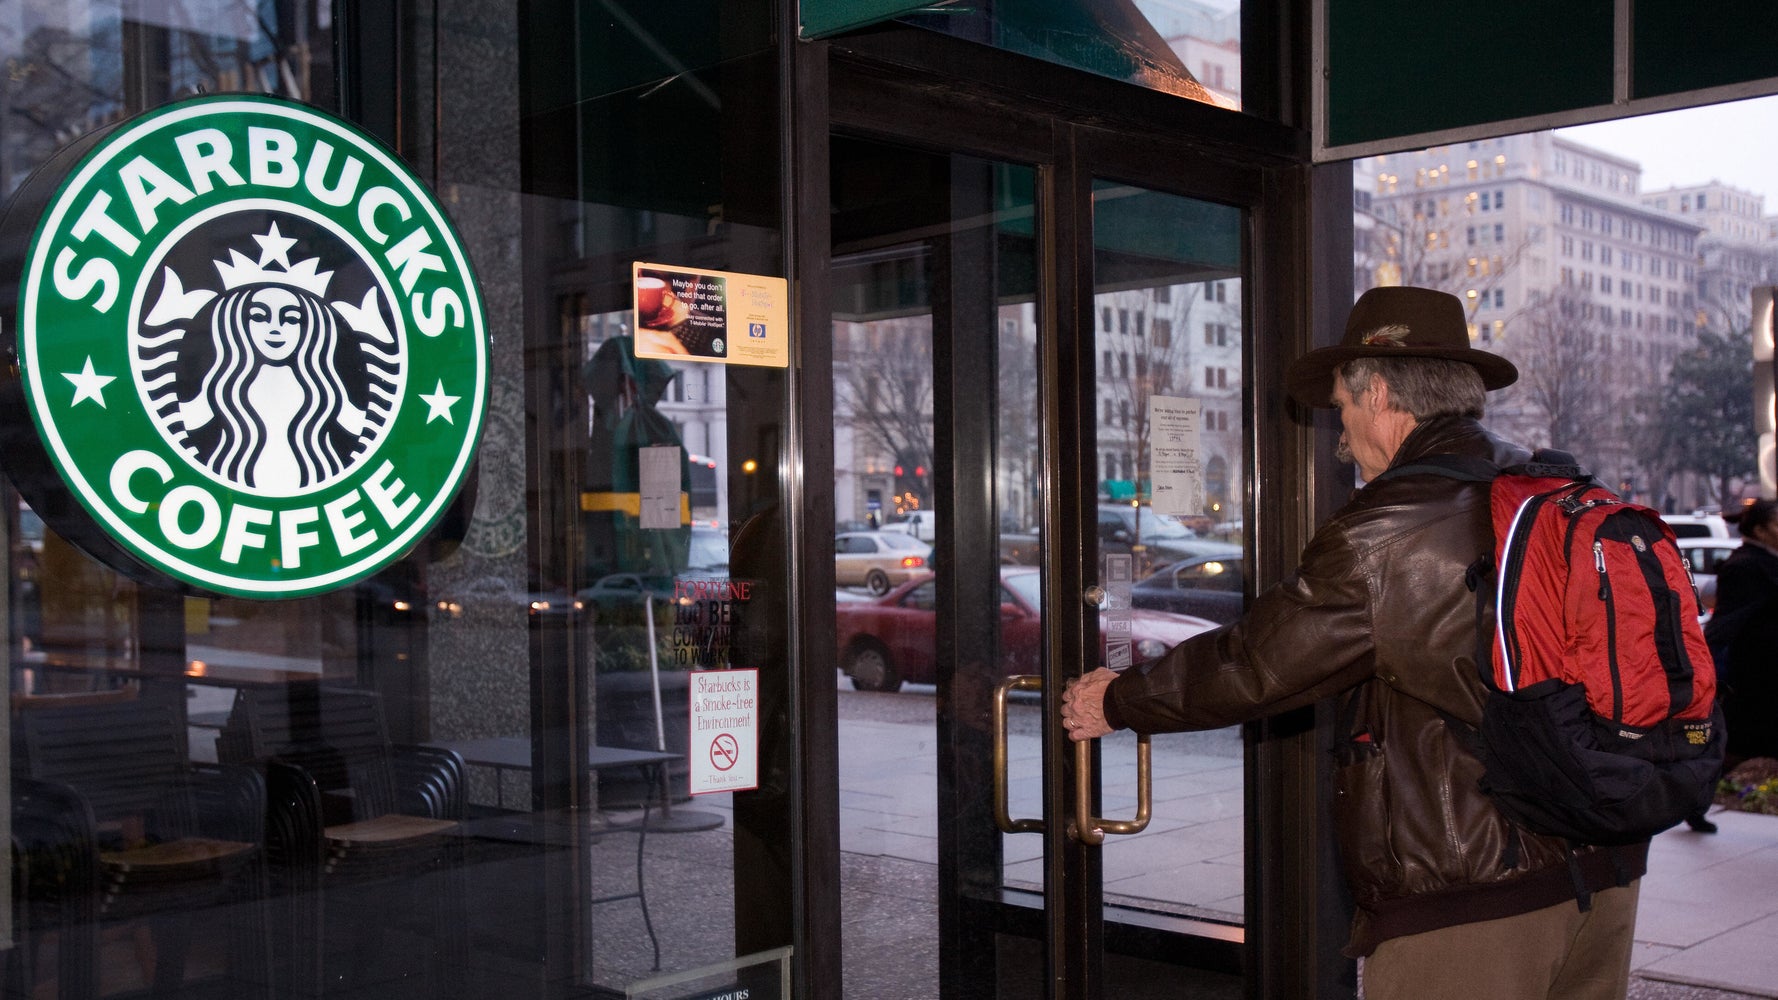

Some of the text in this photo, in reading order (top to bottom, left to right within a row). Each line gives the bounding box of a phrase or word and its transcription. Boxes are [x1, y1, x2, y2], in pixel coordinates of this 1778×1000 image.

[53, 125, 465, 338] STARBUCKS
[672, 279, 693, 289] Maybe
[707, 283, 723, 291] don't
[677, 291, 692, 299] need
[693, 292, 706, 300] that
[700, 303, 715, 311] after
[109, 449, 421, 569] COFFEE
[673, 581, 751, 600] FORTUNE
[674, 600, 749, 626] 100 BES
[1111, 621, 1127, 631] VISA
[673, 648, 688, 665] TO
[691, 648, 725, 665] WORK
[698, 675, 751, 694] Starbucks is
[694, 701, 701, 712] a
[697, 713, 751, 731] Environment
